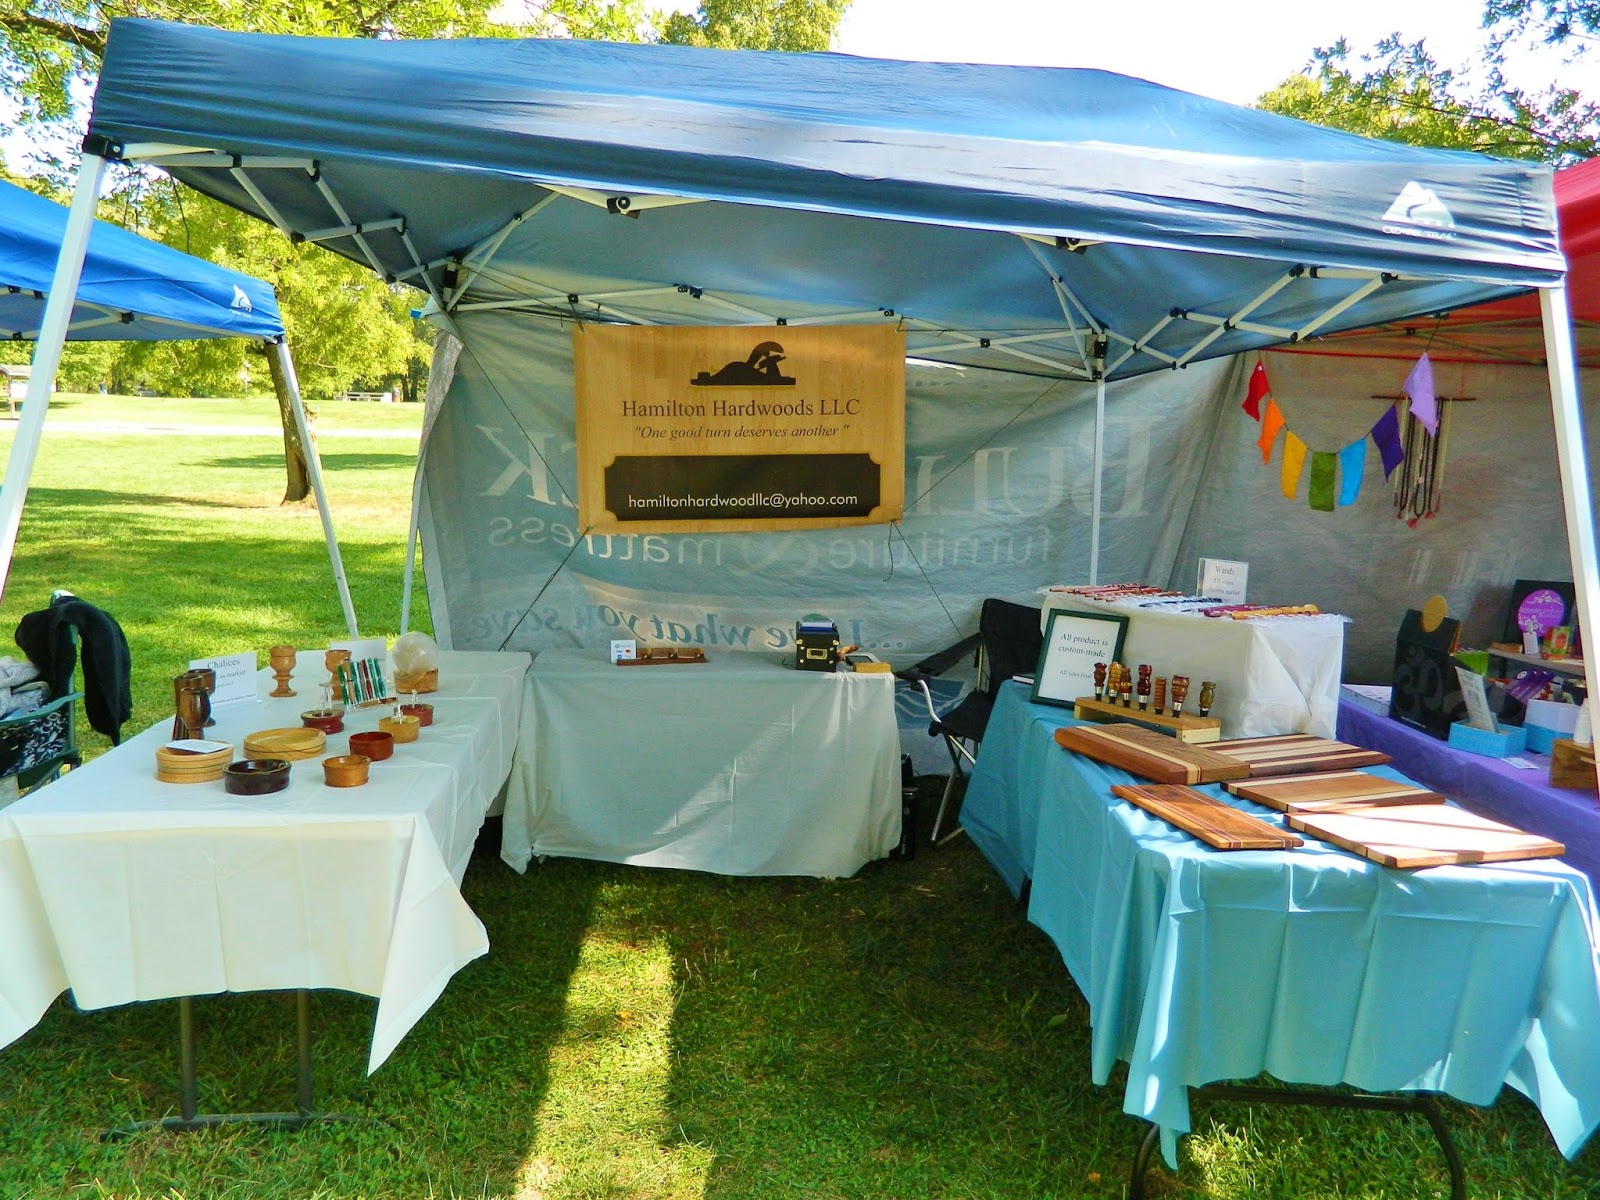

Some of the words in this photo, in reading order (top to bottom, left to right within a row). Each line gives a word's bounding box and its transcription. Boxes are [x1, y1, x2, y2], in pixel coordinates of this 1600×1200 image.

[622, 400, 705, 417] Hamilton
[712, 399, 814, 417] Hardwoods
[820, 398, 860, 416] LLC
[669, 426, 703, 441] good
[705, 428, 731, 438] turn
[734, 425, 788, 438] deserves
[791, 424, 839, 437] another
[628, 492, 858, 510] hamiltonhardwoodllc@yahoo.com
[1061, 633, 1072, 641] All
[1073, 636, 1100, 645] product
[1058, 645, 1106, 658] custom-made
[207, 659, 241, 670] Chalices
